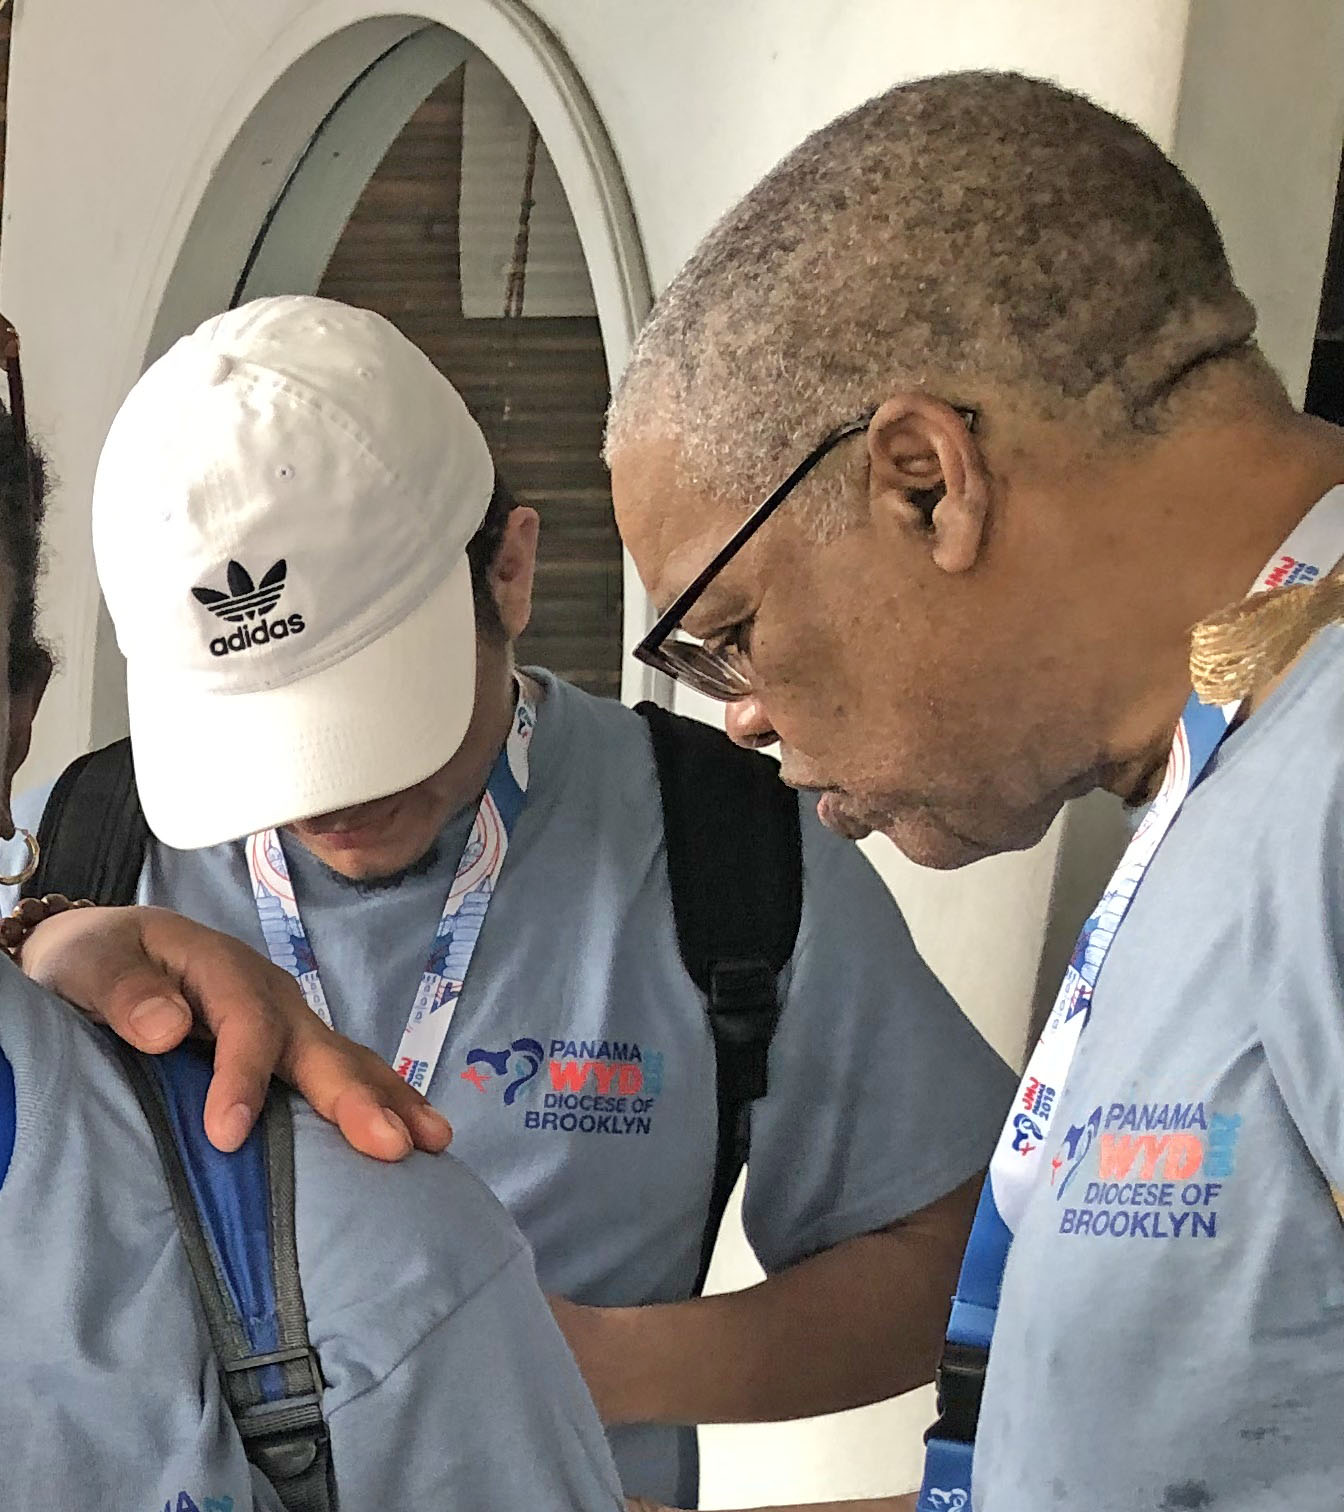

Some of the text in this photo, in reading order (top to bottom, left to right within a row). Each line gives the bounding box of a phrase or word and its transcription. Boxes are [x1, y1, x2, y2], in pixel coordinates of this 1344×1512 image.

[209, 613, 306, 657] adidas
[549, 1039, 643, 1064] PANAMA
[548, 1060, 645, 1097] WYD
[1022, 1076, 1040, 1111] JMJ
[543, 1093, 655, 1115] DIOCESE OF
[1039, 1087, 1056, 1121] 2019
[1104, 1101, 1208, 1132] PANAMA
[524, 1111, 652, 1136] BROOKLYN
[1098, 1132, 1204, 1182] WYD
[1084, 1182, 1223, 1207] DIOCESE OF
[1058, 1208, 1218, 1239] BROOKLYN
